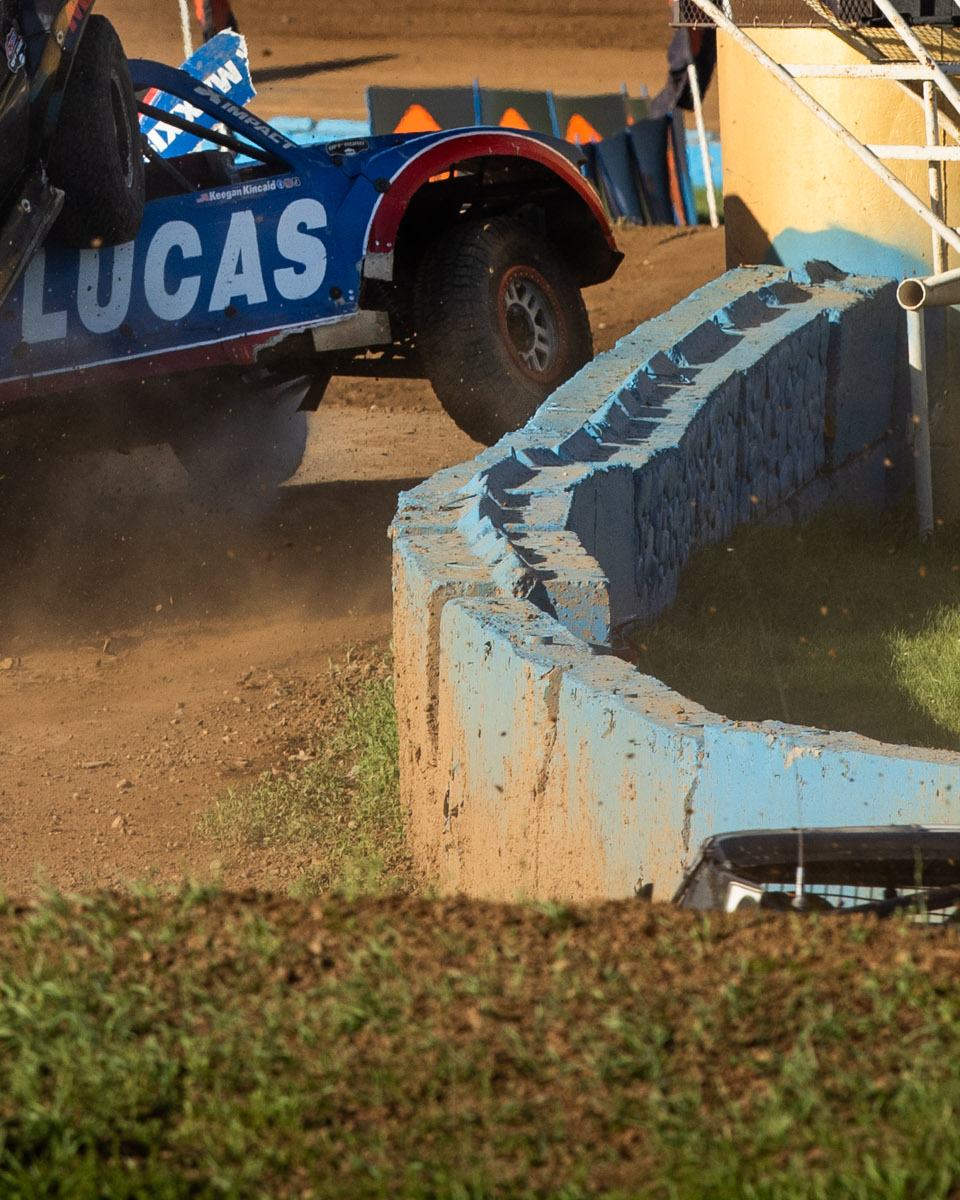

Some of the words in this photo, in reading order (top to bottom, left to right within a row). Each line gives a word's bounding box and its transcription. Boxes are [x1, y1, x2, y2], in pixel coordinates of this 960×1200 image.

[221, 102, 297, 150] IMPACT
[209, 188, 242, 201] Keegan
[243, 180, 277, 196] Kincaid
[21, 197, 328, 345] LUCAS
